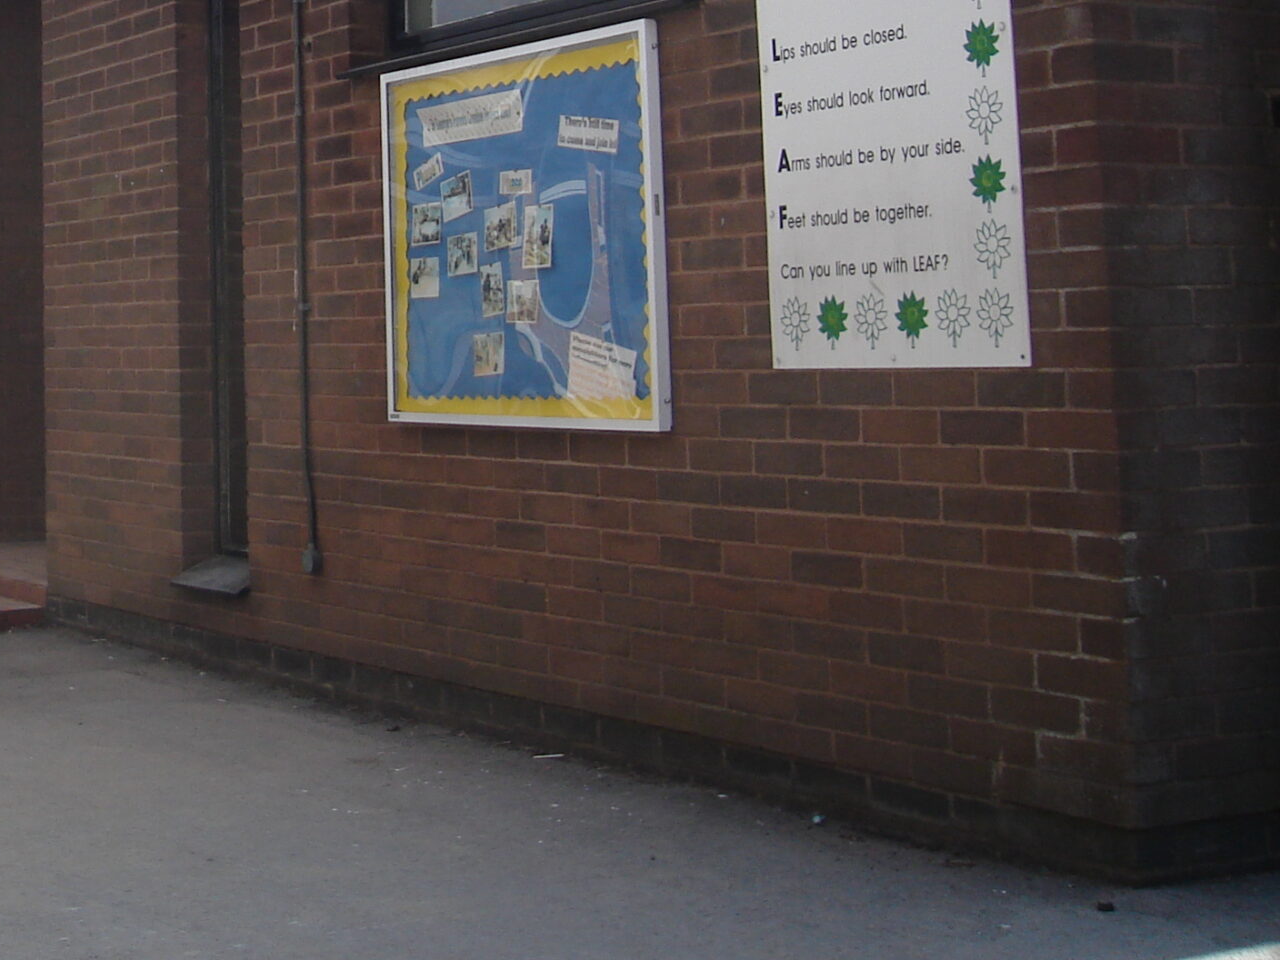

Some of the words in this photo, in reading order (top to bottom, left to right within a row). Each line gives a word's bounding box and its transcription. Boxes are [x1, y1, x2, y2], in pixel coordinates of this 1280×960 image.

[772, 38, 795, 62] Lips
[800, 36, 836, 57] should
[841, 34, 857, 49] be
[863, 24, 907, 46] closed.
[775, 92, 802, 119] Eyes
[807, 92, 844, 112] should
[849, 89, 874, 105] look
[880, 79, 930, 101] forward.
[778, 148, 811, 173] Arms
[816, 149, 853, 168] should
[858, 148, 875, 163] be
[880, 145, 896, 164] by
[901, 143, 930, 162] your
[935, 137, 965, 155] side.
[779, 205, 806, 229] Feet
[811, 208, 848, 226] should
[853, 207, 870, 223] be
[875, 203, 933, 224] together.
[780, 263, 805, 280] Can
[809, 264, 831, 281] you
[835, 260, 857, 277] line
[861, 261, 878, 278] up
[883, 257, 908, 273] with
[912, 253, 949, 272] LEAF?
